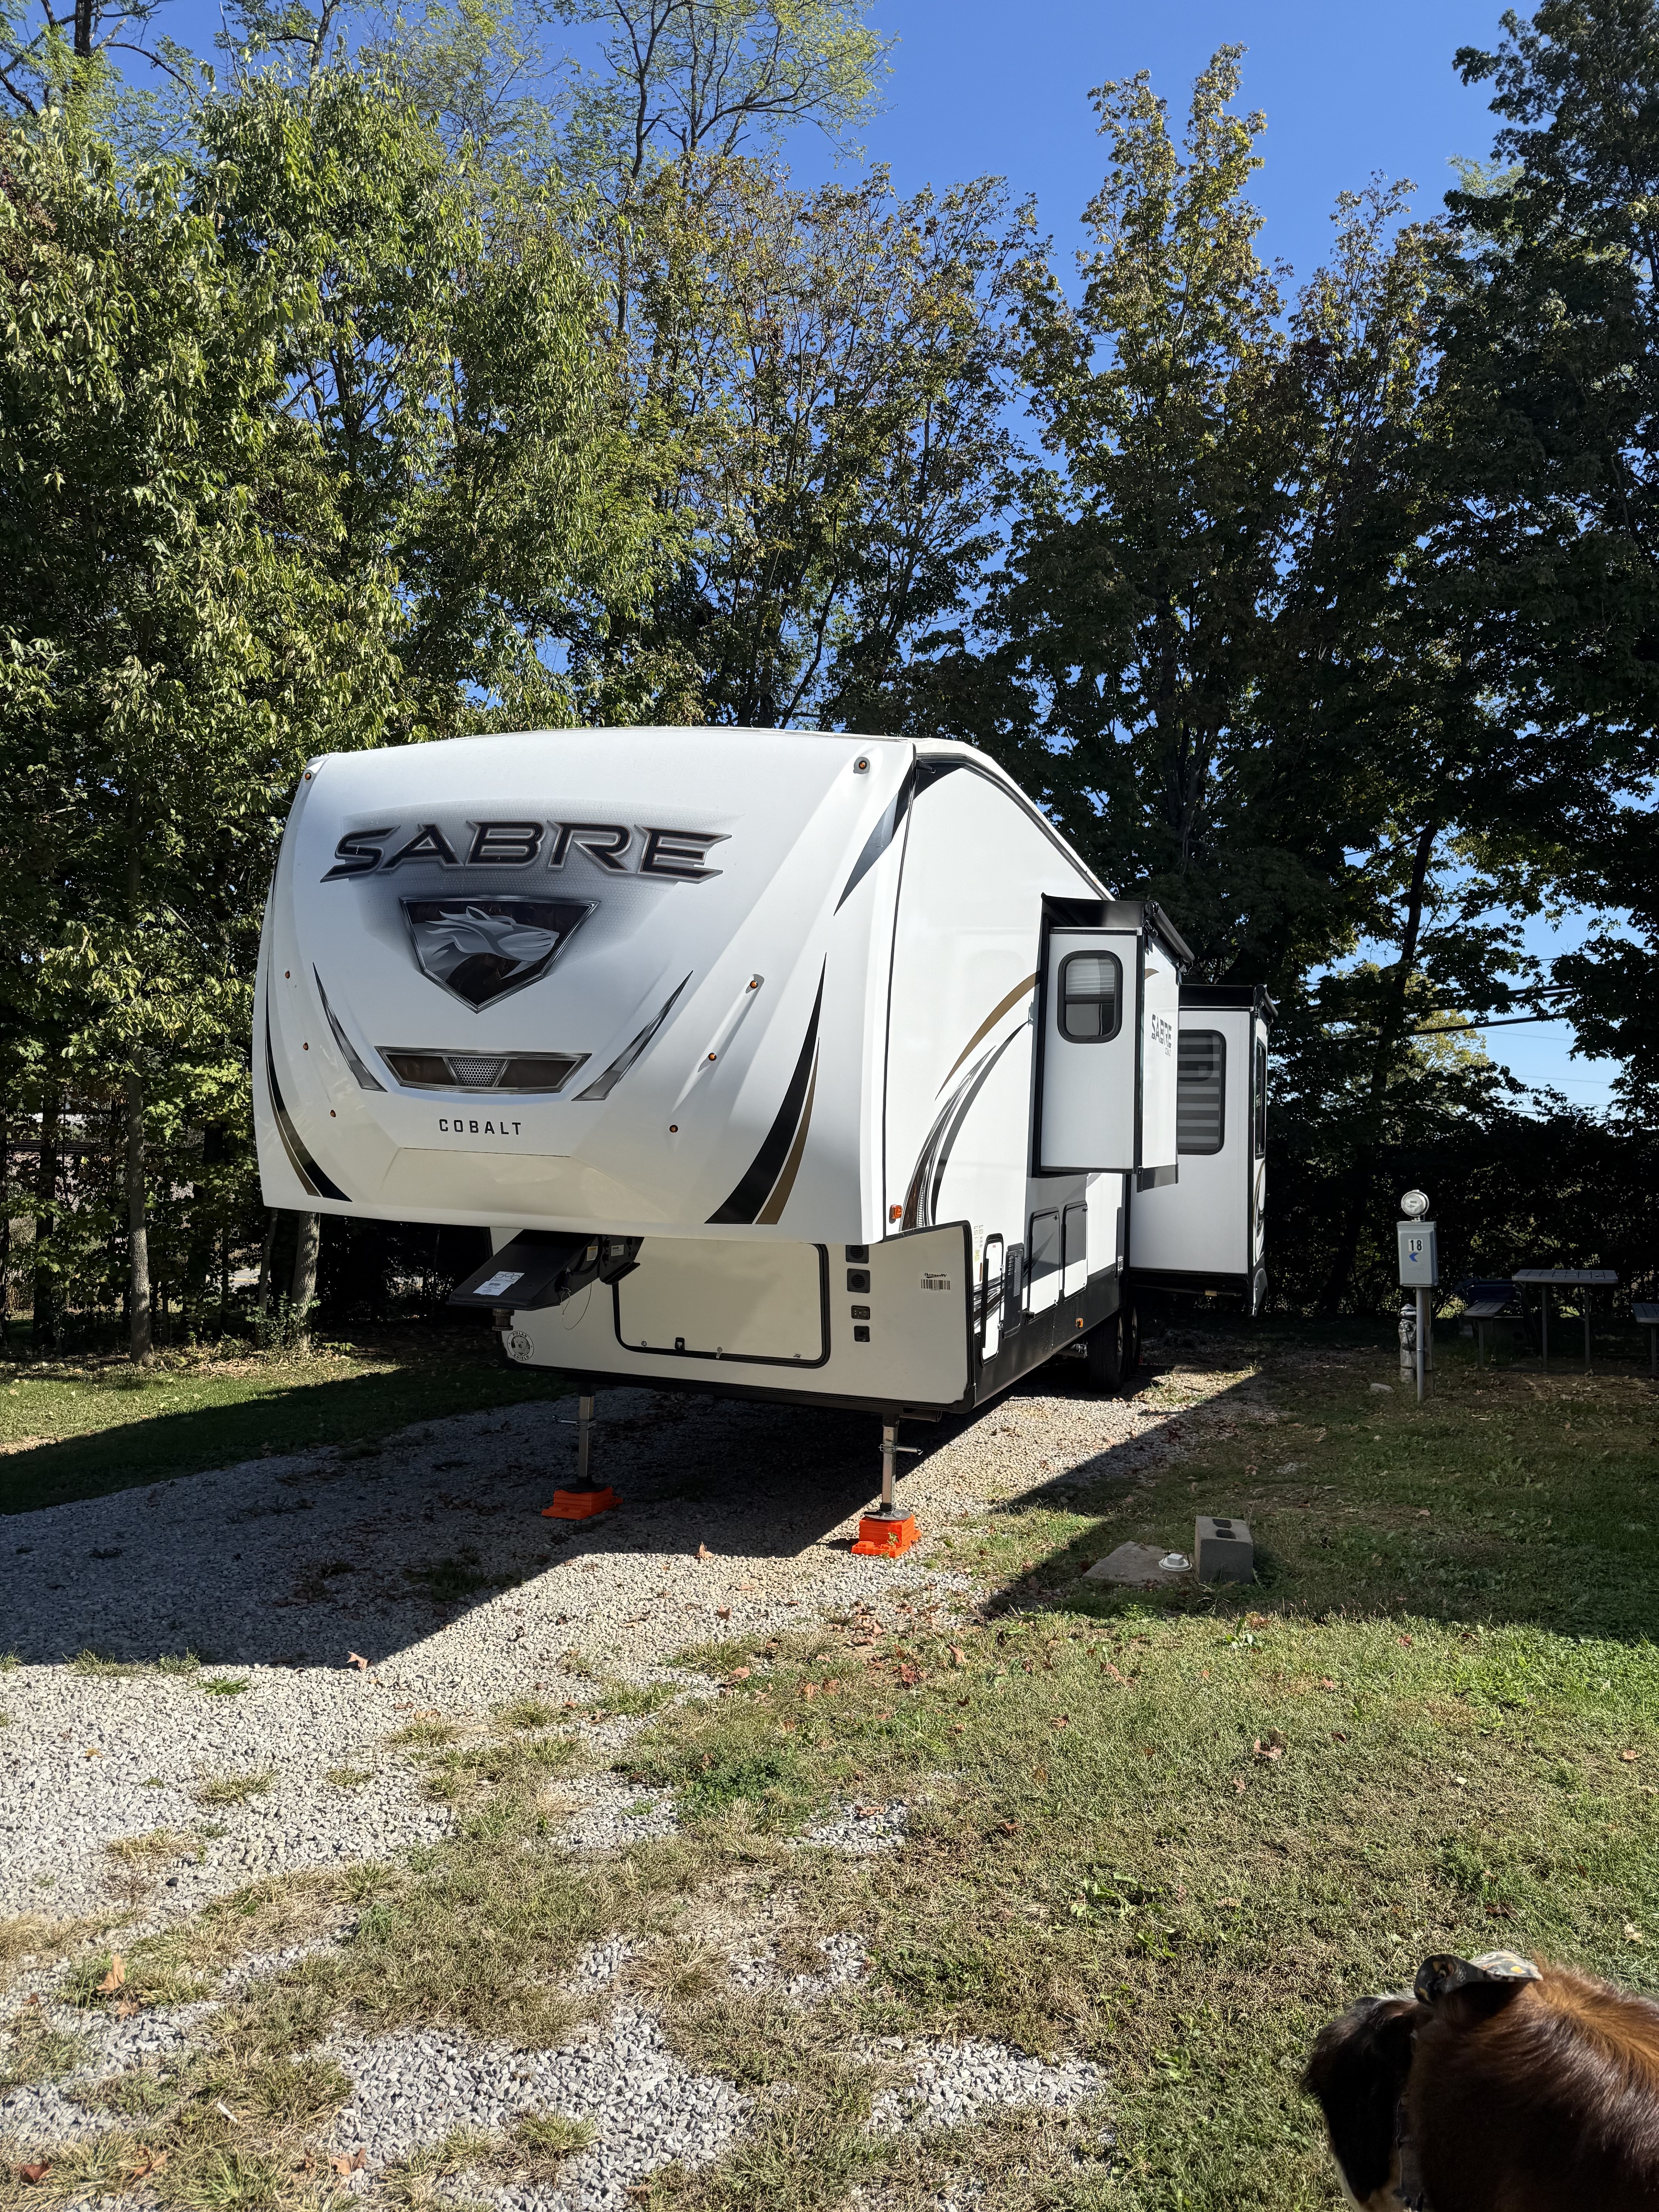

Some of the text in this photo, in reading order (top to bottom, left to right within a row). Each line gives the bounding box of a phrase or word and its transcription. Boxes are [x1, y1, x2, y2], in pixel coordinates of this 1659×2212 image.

[320, 819, 732, 884] SABRE
[1151, 1014, 1172, 1048] SABRE
[439, 1119, 521, 1135] COBALT
[1410, 1240, 1422, 1251] 18
